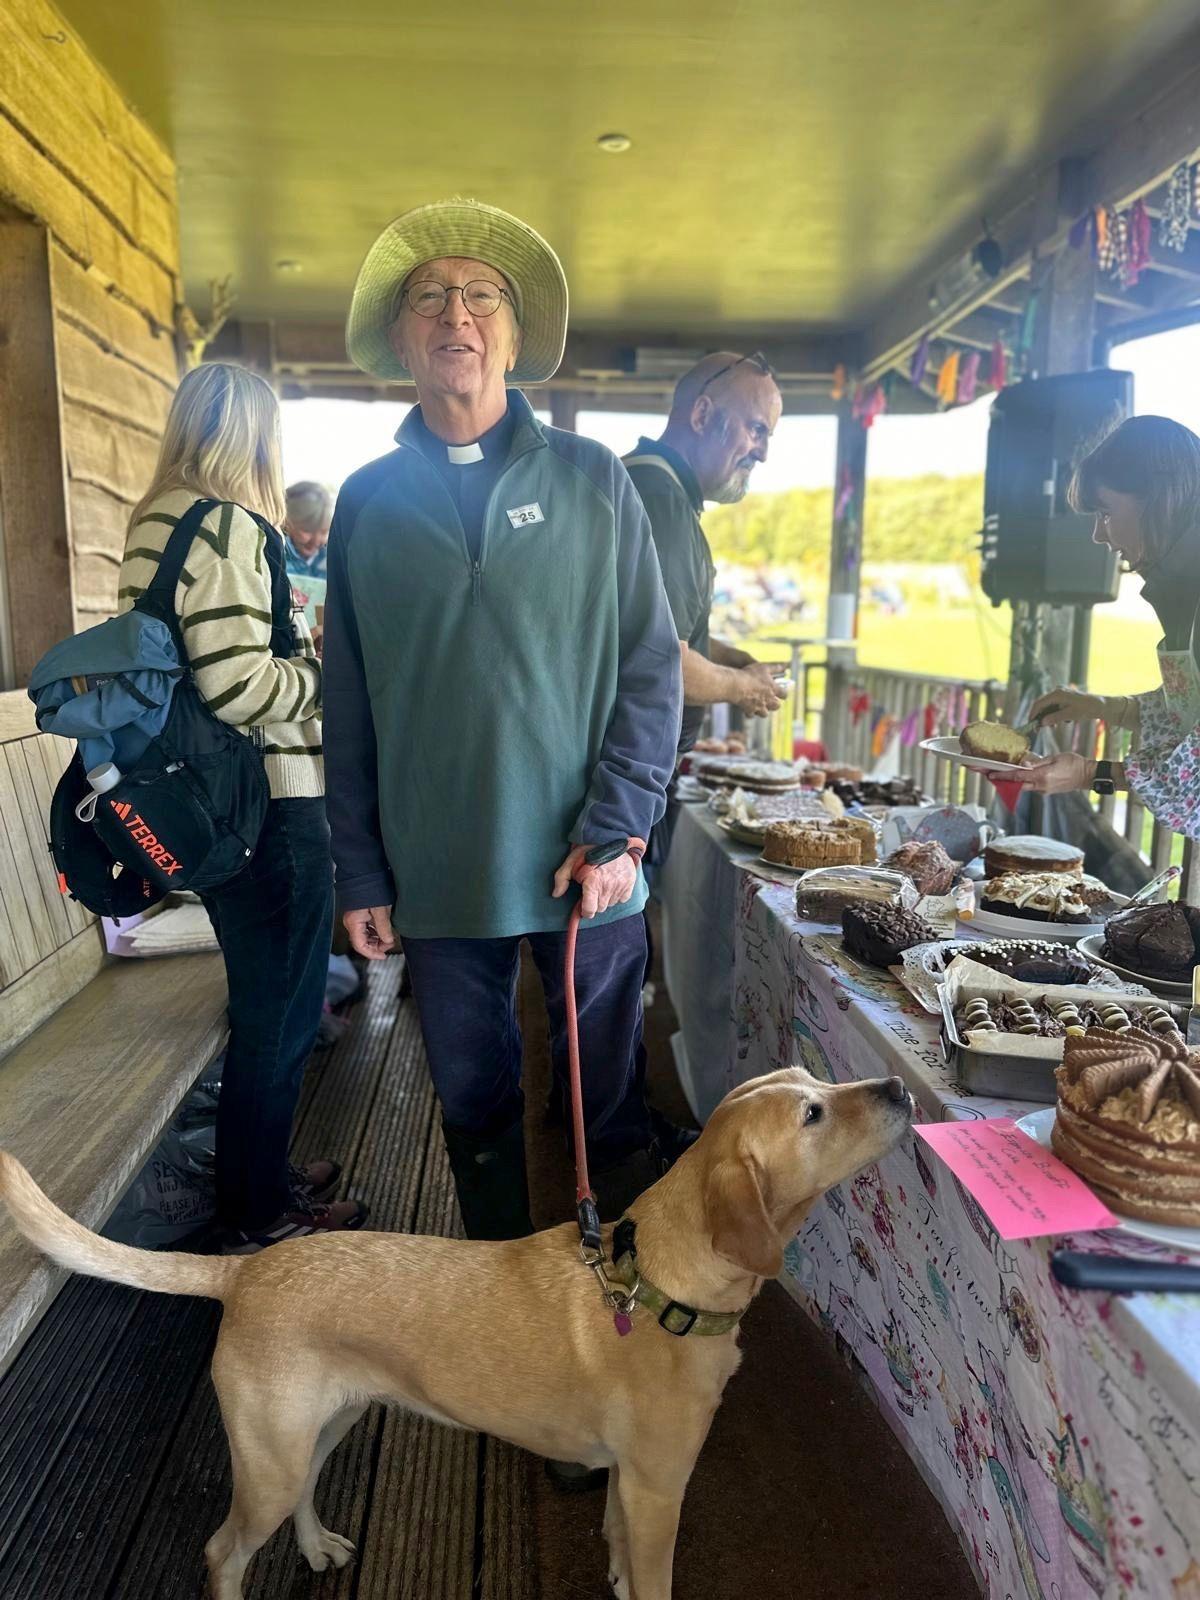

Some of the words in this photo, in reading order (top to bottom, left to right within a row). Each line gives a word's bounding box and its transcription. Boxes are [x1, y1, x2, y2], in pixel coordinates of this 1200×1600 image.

[520, 511, 536, 523] 25
[125, 813, 183, 877] TERREX
[884, 1020, 919, 1046] Time
[914, 1049, 947, 1071] for
